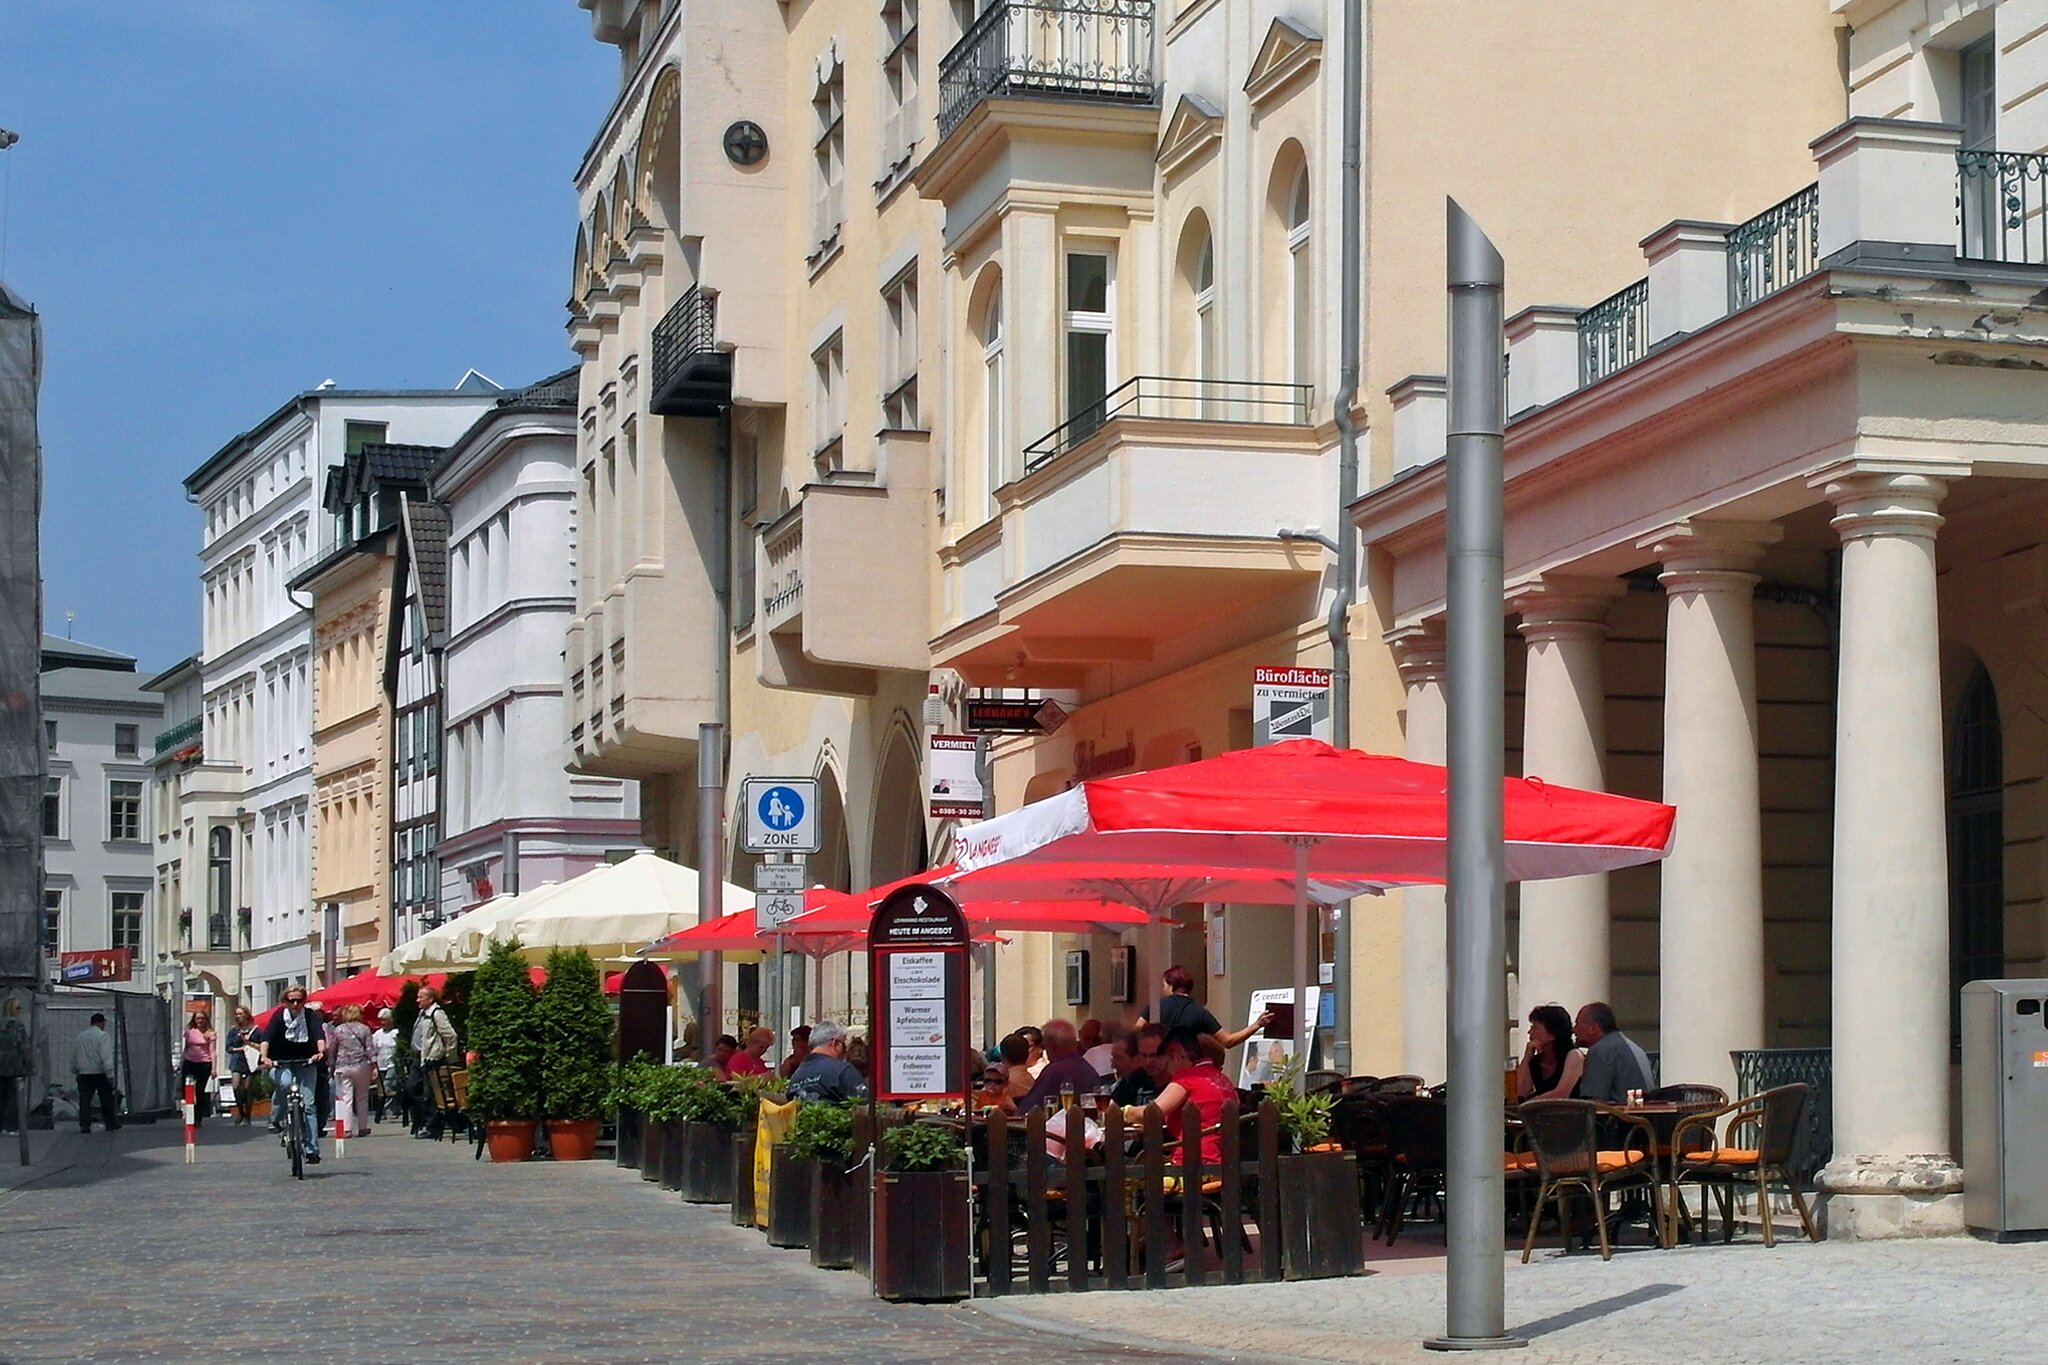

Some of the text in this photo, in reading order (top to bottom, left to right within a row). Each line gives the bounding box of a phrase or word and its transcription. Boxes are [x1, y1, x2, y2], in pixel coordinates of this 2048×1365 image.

[1256, 669, 1328, 685] Bürofläche
[1256, 688, 1325, 700] zu vermieten
[763, 833, 799, 845] ZONE
[889, 927, 911, 936] HEUTE
[920, 926, 953, 935] ANGEBOT
[902, 957, 934, 965] Eiskaffee
[893, 976, 940, 985] Eisschokolade
[1261, 991, 1289, 1001] central
[904, 1006, 932, 1014] Warmer
[896, 1016, 938, 1025] Apfelstrudel
[902, 1062, 932, 1070] Erdbeeren
